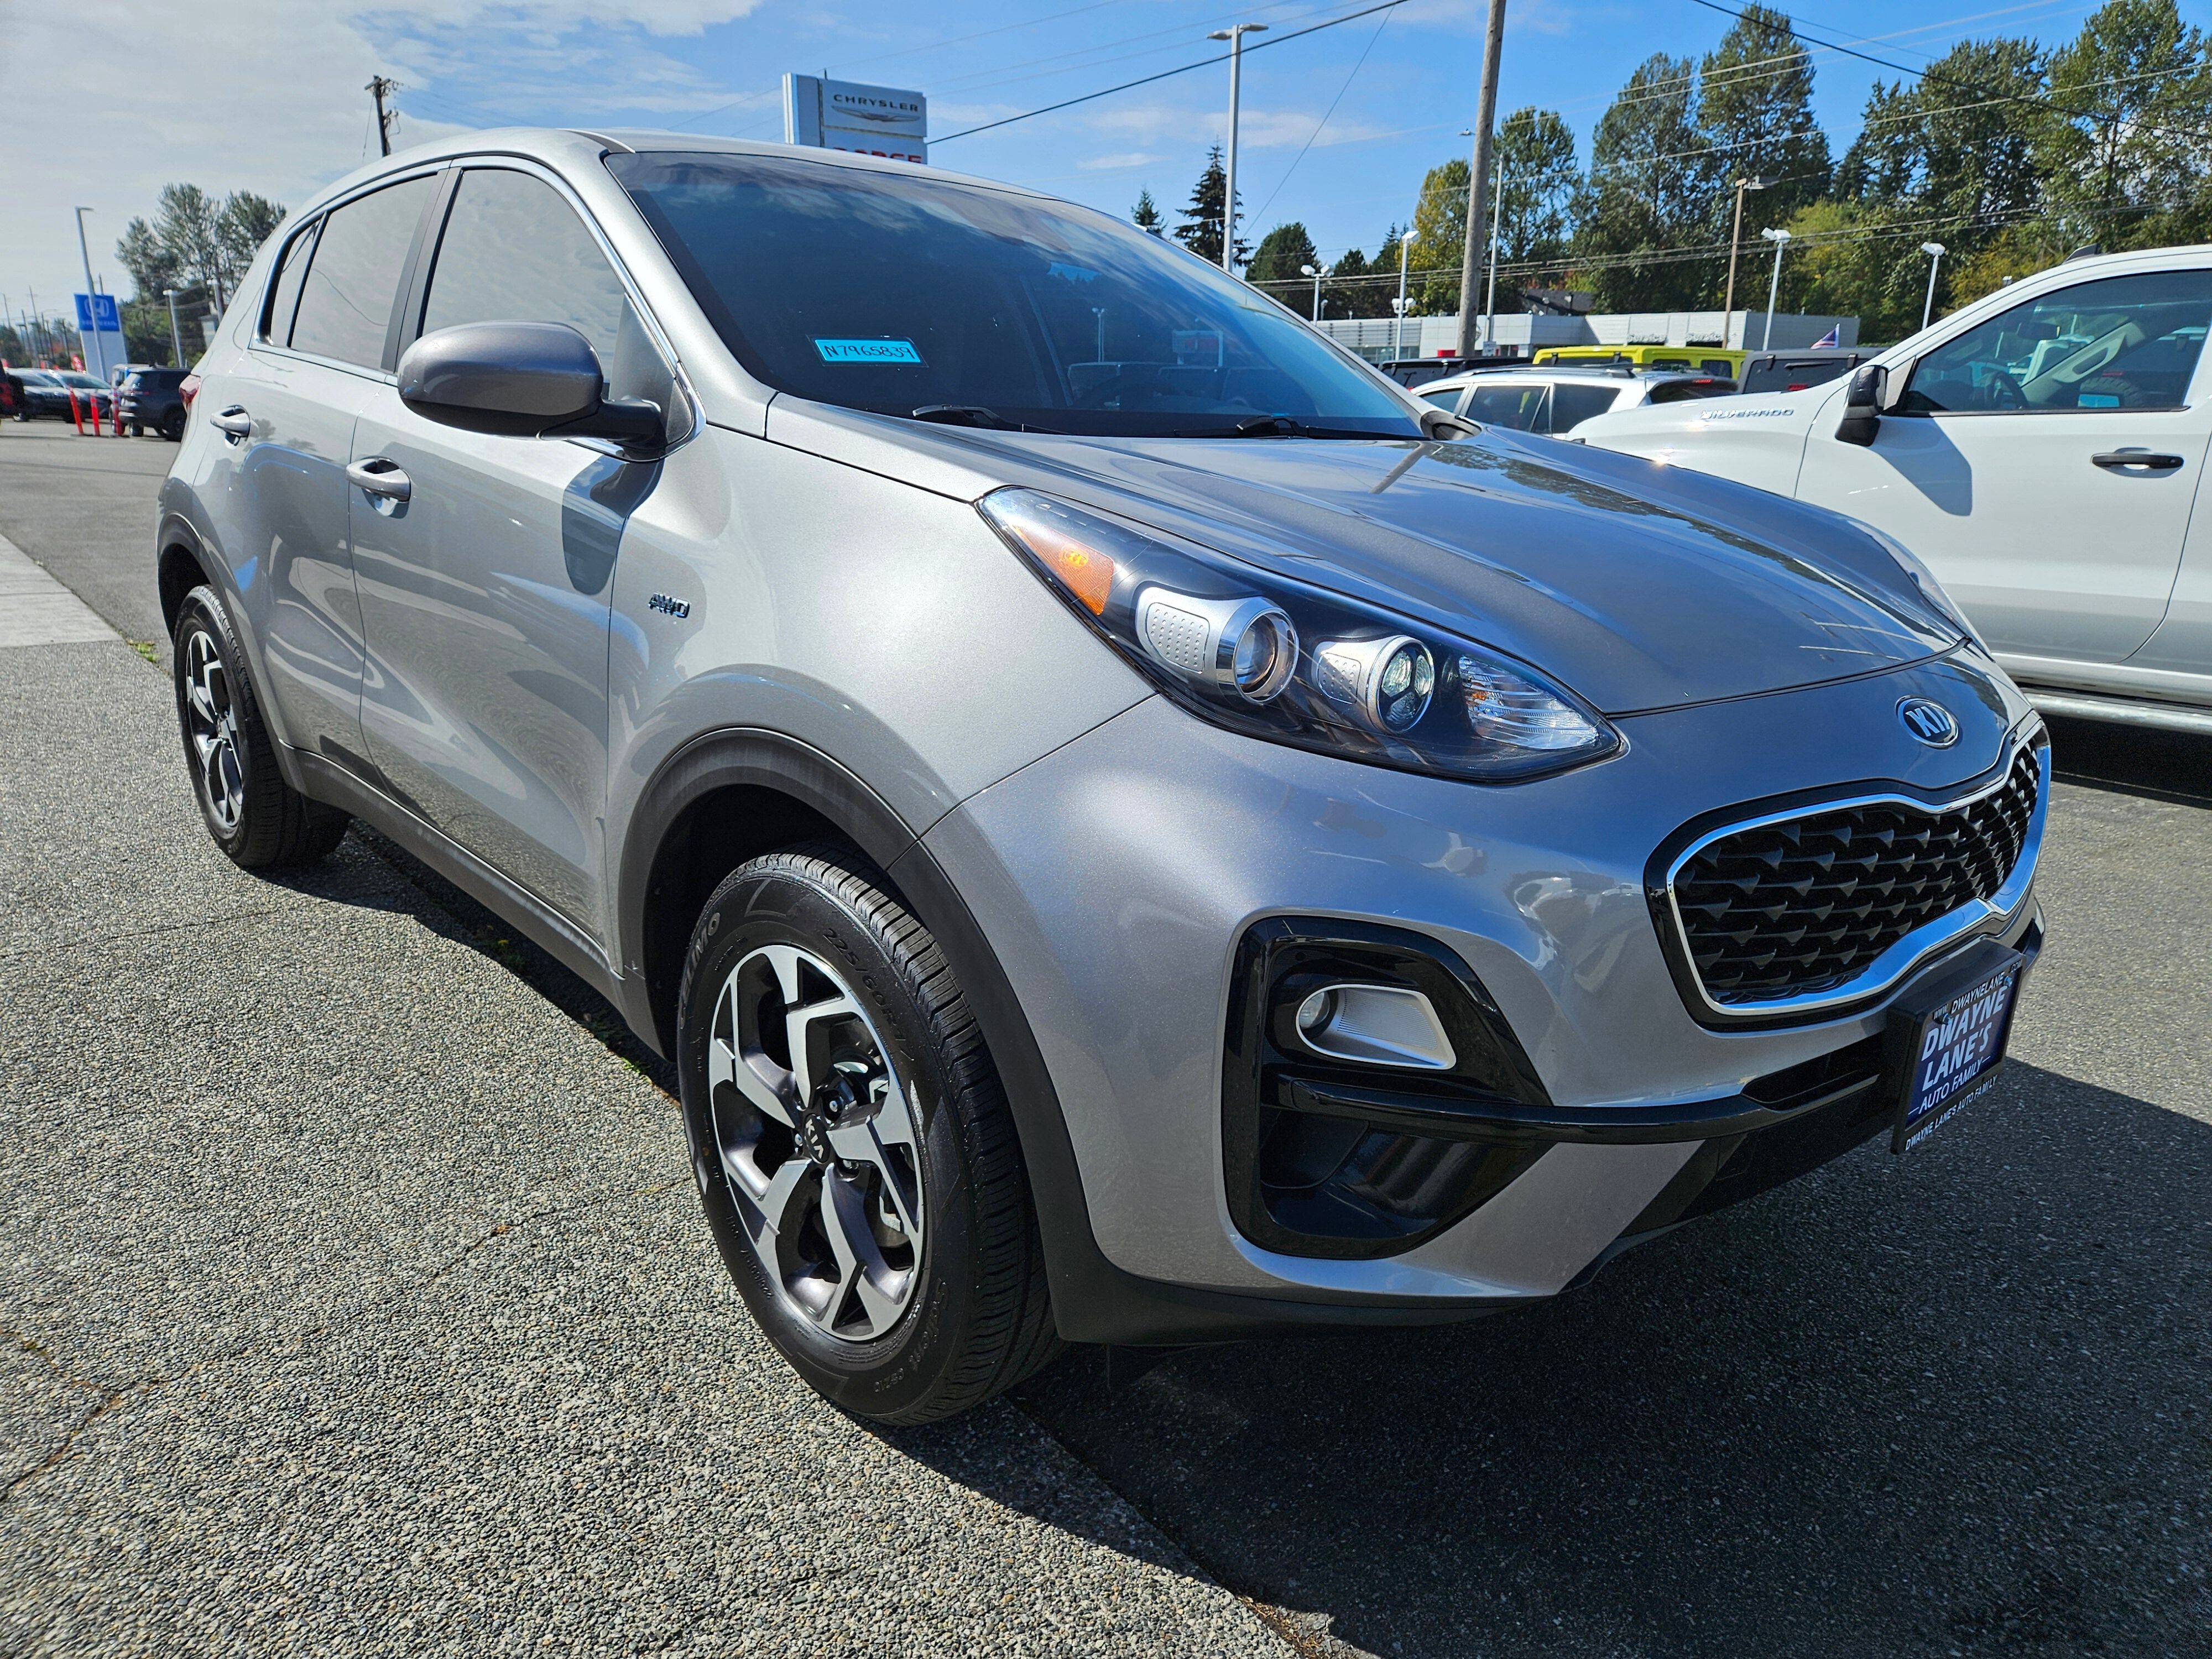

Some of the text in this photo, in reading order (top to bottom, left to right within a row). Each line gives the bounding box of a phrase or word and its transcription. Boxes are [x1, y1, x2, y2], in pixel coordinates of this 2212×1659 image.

[833, 93, 919, 112] CHRYSLER
[824, 345, 915, 359] N7965839
[1700, 407, 1794, 420] SILVERADO
[648, 592, 690, 619] AWD
[822, 927, 916, 1062] 225/60R17
[1921, 985, 2008, 1061] DWAYNE
[1922, 1022, 1992, 1092] LANE'S
[1918, 1056, 1984, 1114] AUTO FAMILY
[1905, 1121, 1934, 1151] DWAYNE
[1957, 1092, 1974, 1112] AUTO
[1974, 1074, 1997, 1099] FAMILY
[805, 1118, 824, 1159] KIA
